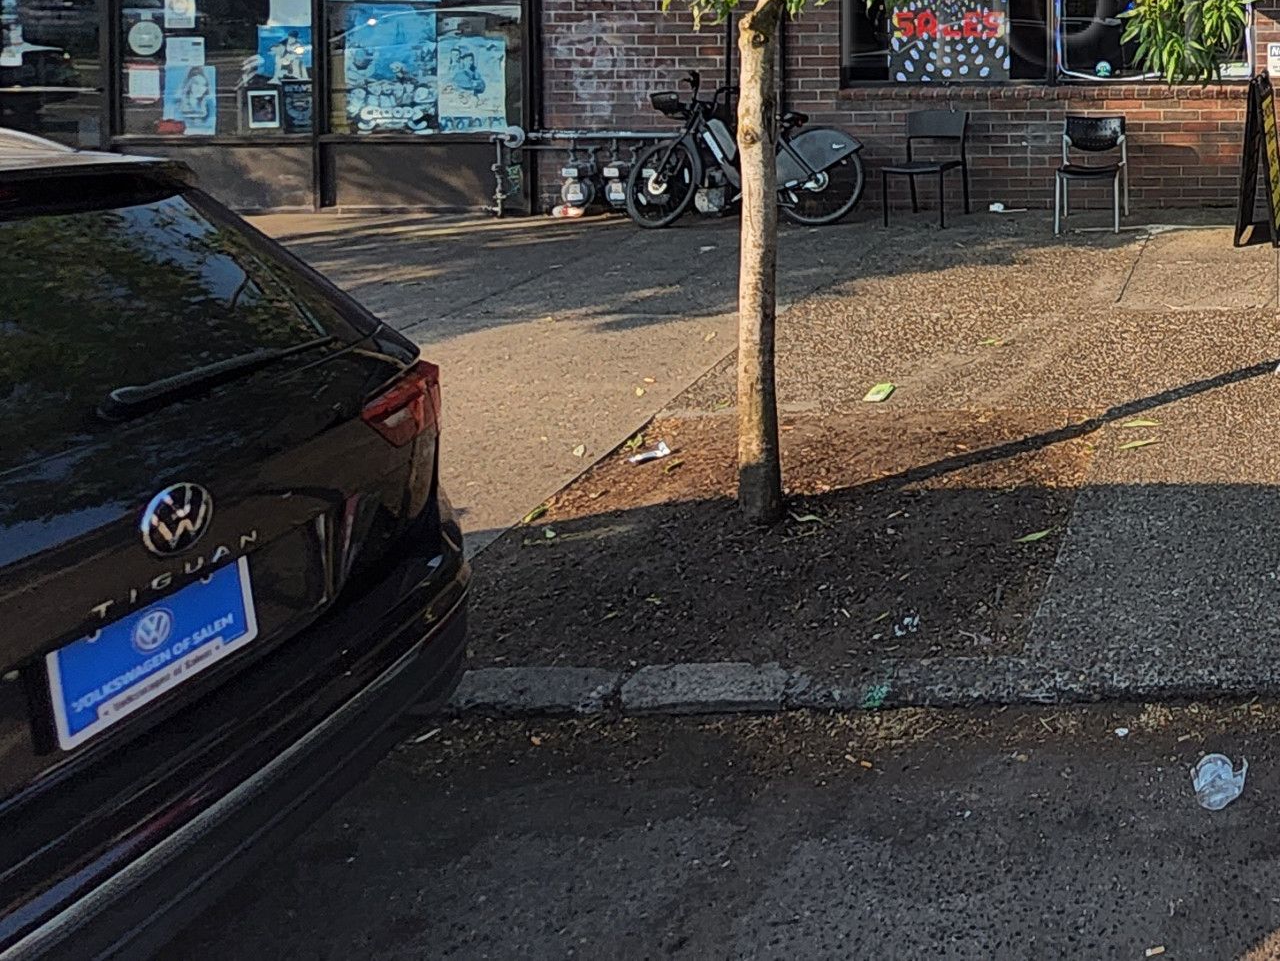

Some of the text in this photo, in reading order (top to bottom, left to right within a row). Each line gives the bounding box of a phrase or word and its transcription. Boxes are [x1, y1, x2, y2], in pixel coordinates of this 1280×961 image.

[91, 529, 258, 619] TIGUAN
[71, 612, 234, 713] VOLKSWAGEN OF SALEM
